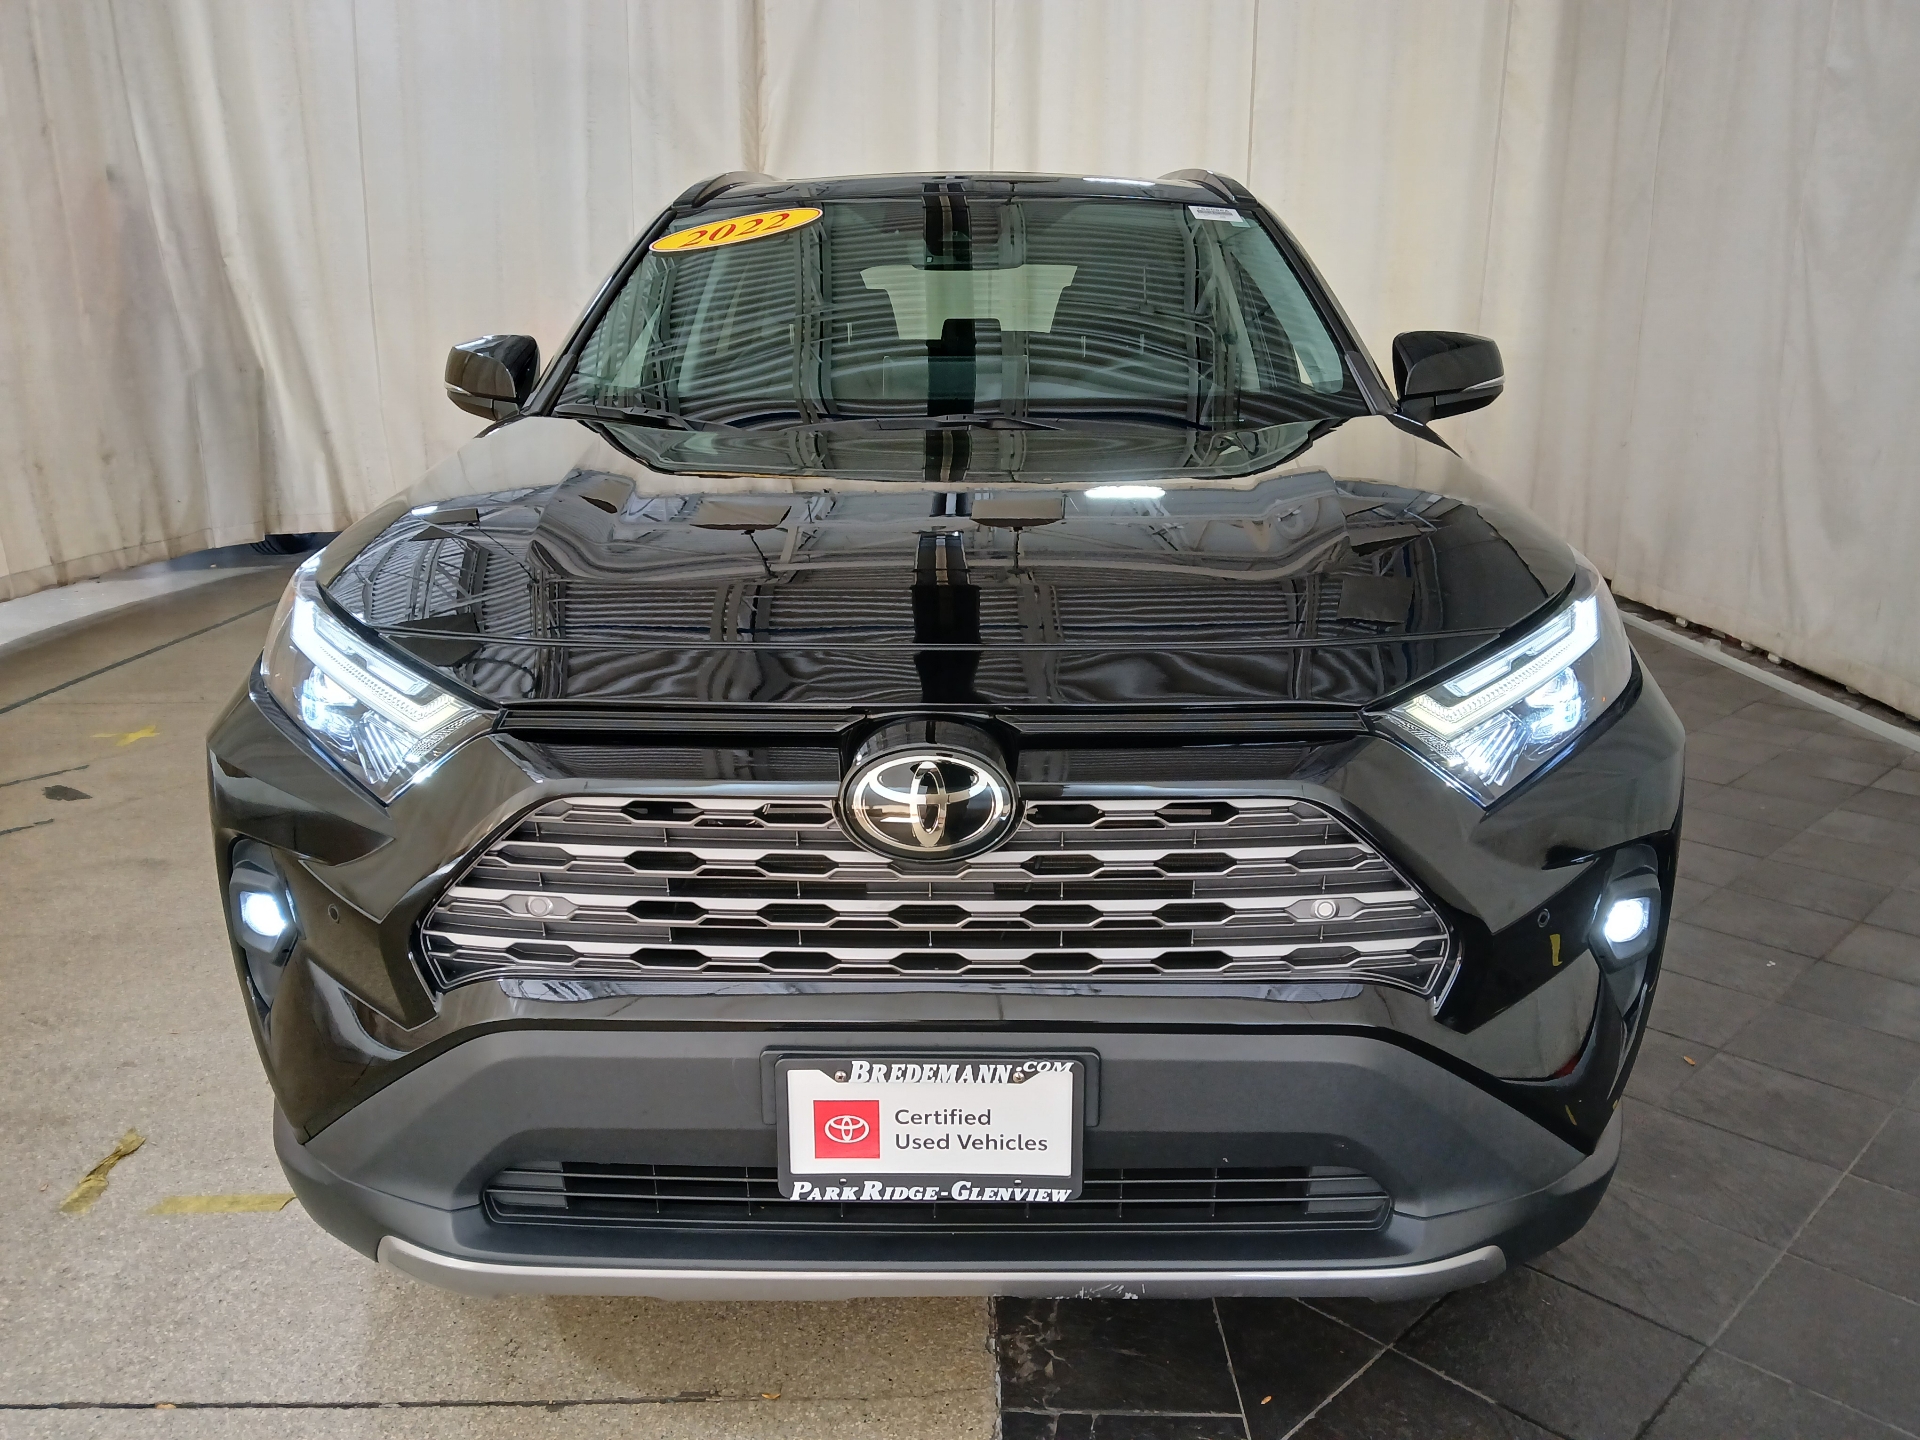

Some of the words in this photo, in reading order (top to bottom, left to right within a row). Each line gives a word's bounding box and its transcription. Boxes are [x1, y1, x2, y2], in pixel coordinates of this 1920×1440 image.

[679, 212, 790, 249] 2022
[894, 1108, 992, 1126] Certified
[895, 1133, 950, 1151] Used
[956, 1133, 1049, 1151] Vehicles
[789, 1180, 859, 1201] PARK
